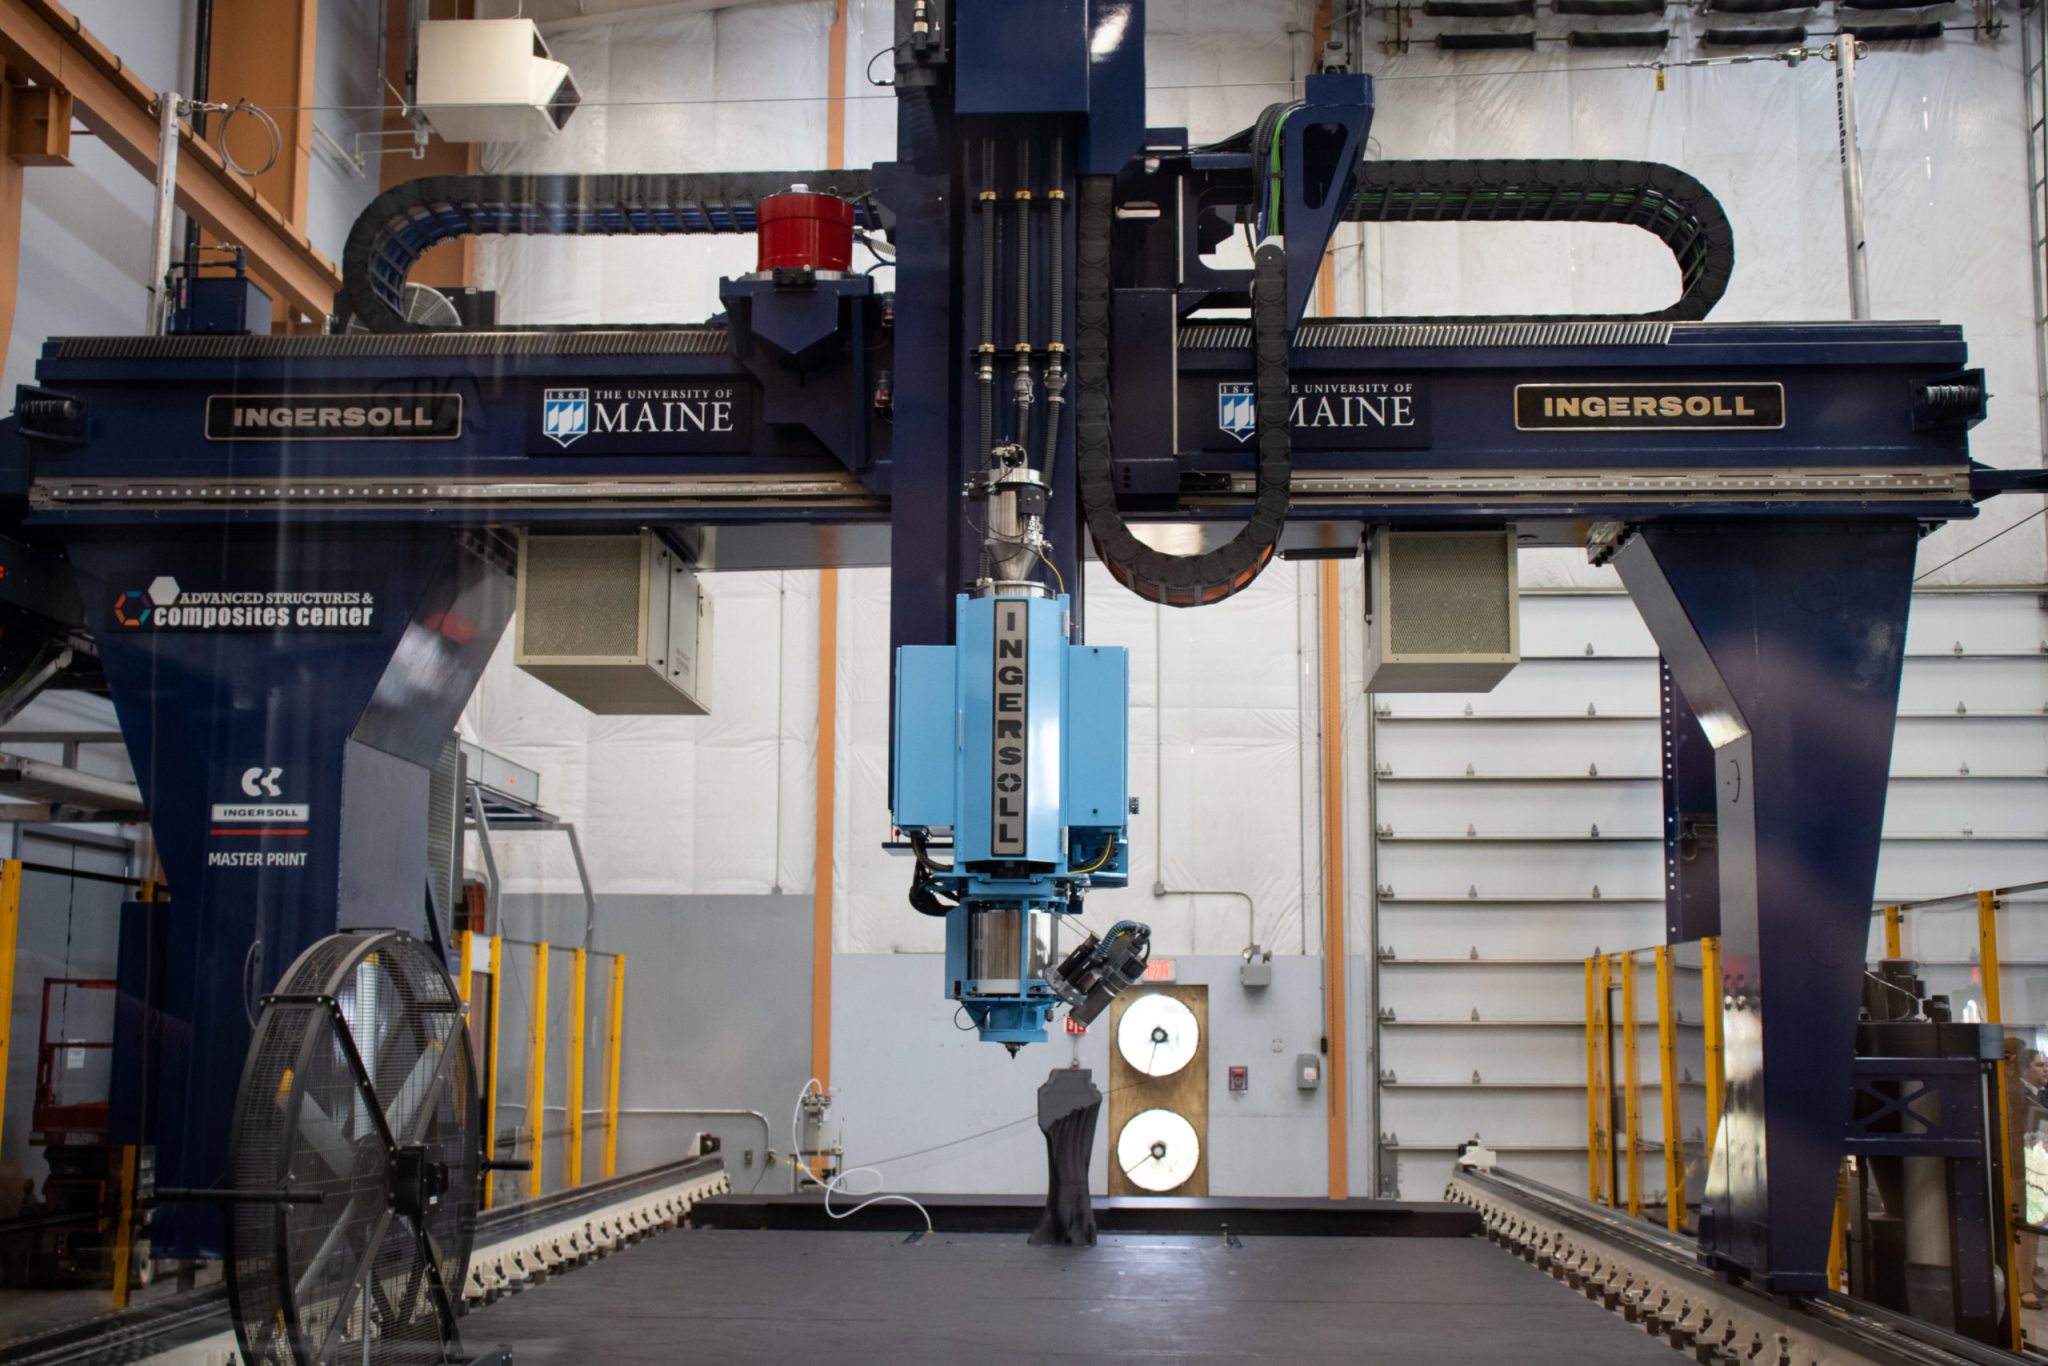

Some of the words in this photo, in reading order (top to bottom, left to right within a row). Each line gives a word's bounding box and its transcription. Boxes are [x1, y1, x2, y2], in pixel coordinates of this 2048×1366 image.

[548, 391, 585, 399] 1865
[594, 390, 622, 399] THE
[628, 389, 710, 399] UNIVERSITY
[715, 389, 733, 398] OF
[1223, 385, 1250, 394] 186
[1304, 384, 1389, 393] UNIVERSITY
[1394, 384, 1413, 393] OF
[1544, 396, 1755, 417] INGERSOLL
[233, 406, 433, 427] INGERSOLL
[592, 401, 734, 433] MAINE
[179, 592, 264, 605] ADVANCED
[265, 592, 360, 605] STRUCTURES
[361, 592, 374, 605] &
[153, 607, 290, 629] composites
[296, 607, 373, 626] center
[997, 612, 1024, 843] INGERSOLL
[223, 808, 299, 817] INGERSOLL
[208, 852, 263, 866] MASTER
[266, 852, 308, 866] PRINT
